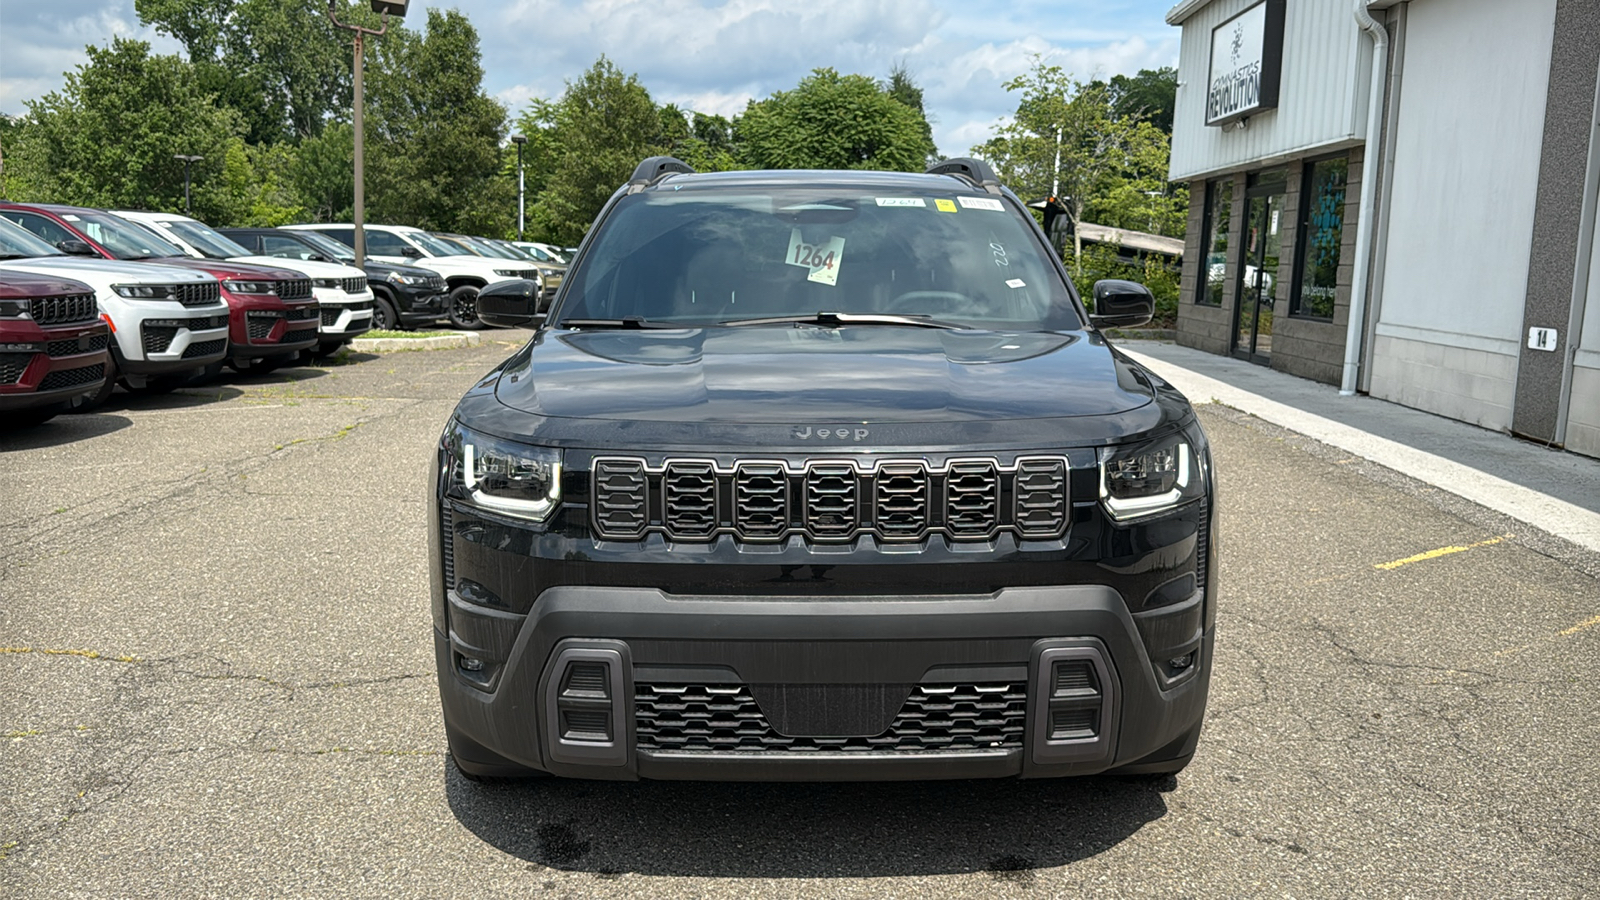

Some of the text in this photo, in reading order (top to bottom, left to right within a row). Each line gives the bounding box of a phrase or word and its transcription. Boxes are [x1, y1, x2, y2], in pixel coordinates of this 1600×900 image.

[1212, 60, 1260, 91] GYMNASTICS
[1208, 72, 1261, 120] REVOLUTION
[794, 244, 835, 270] 1264
[1537, 329, 1548, 348] 14
[796, 426, 869, 441] Jeep
